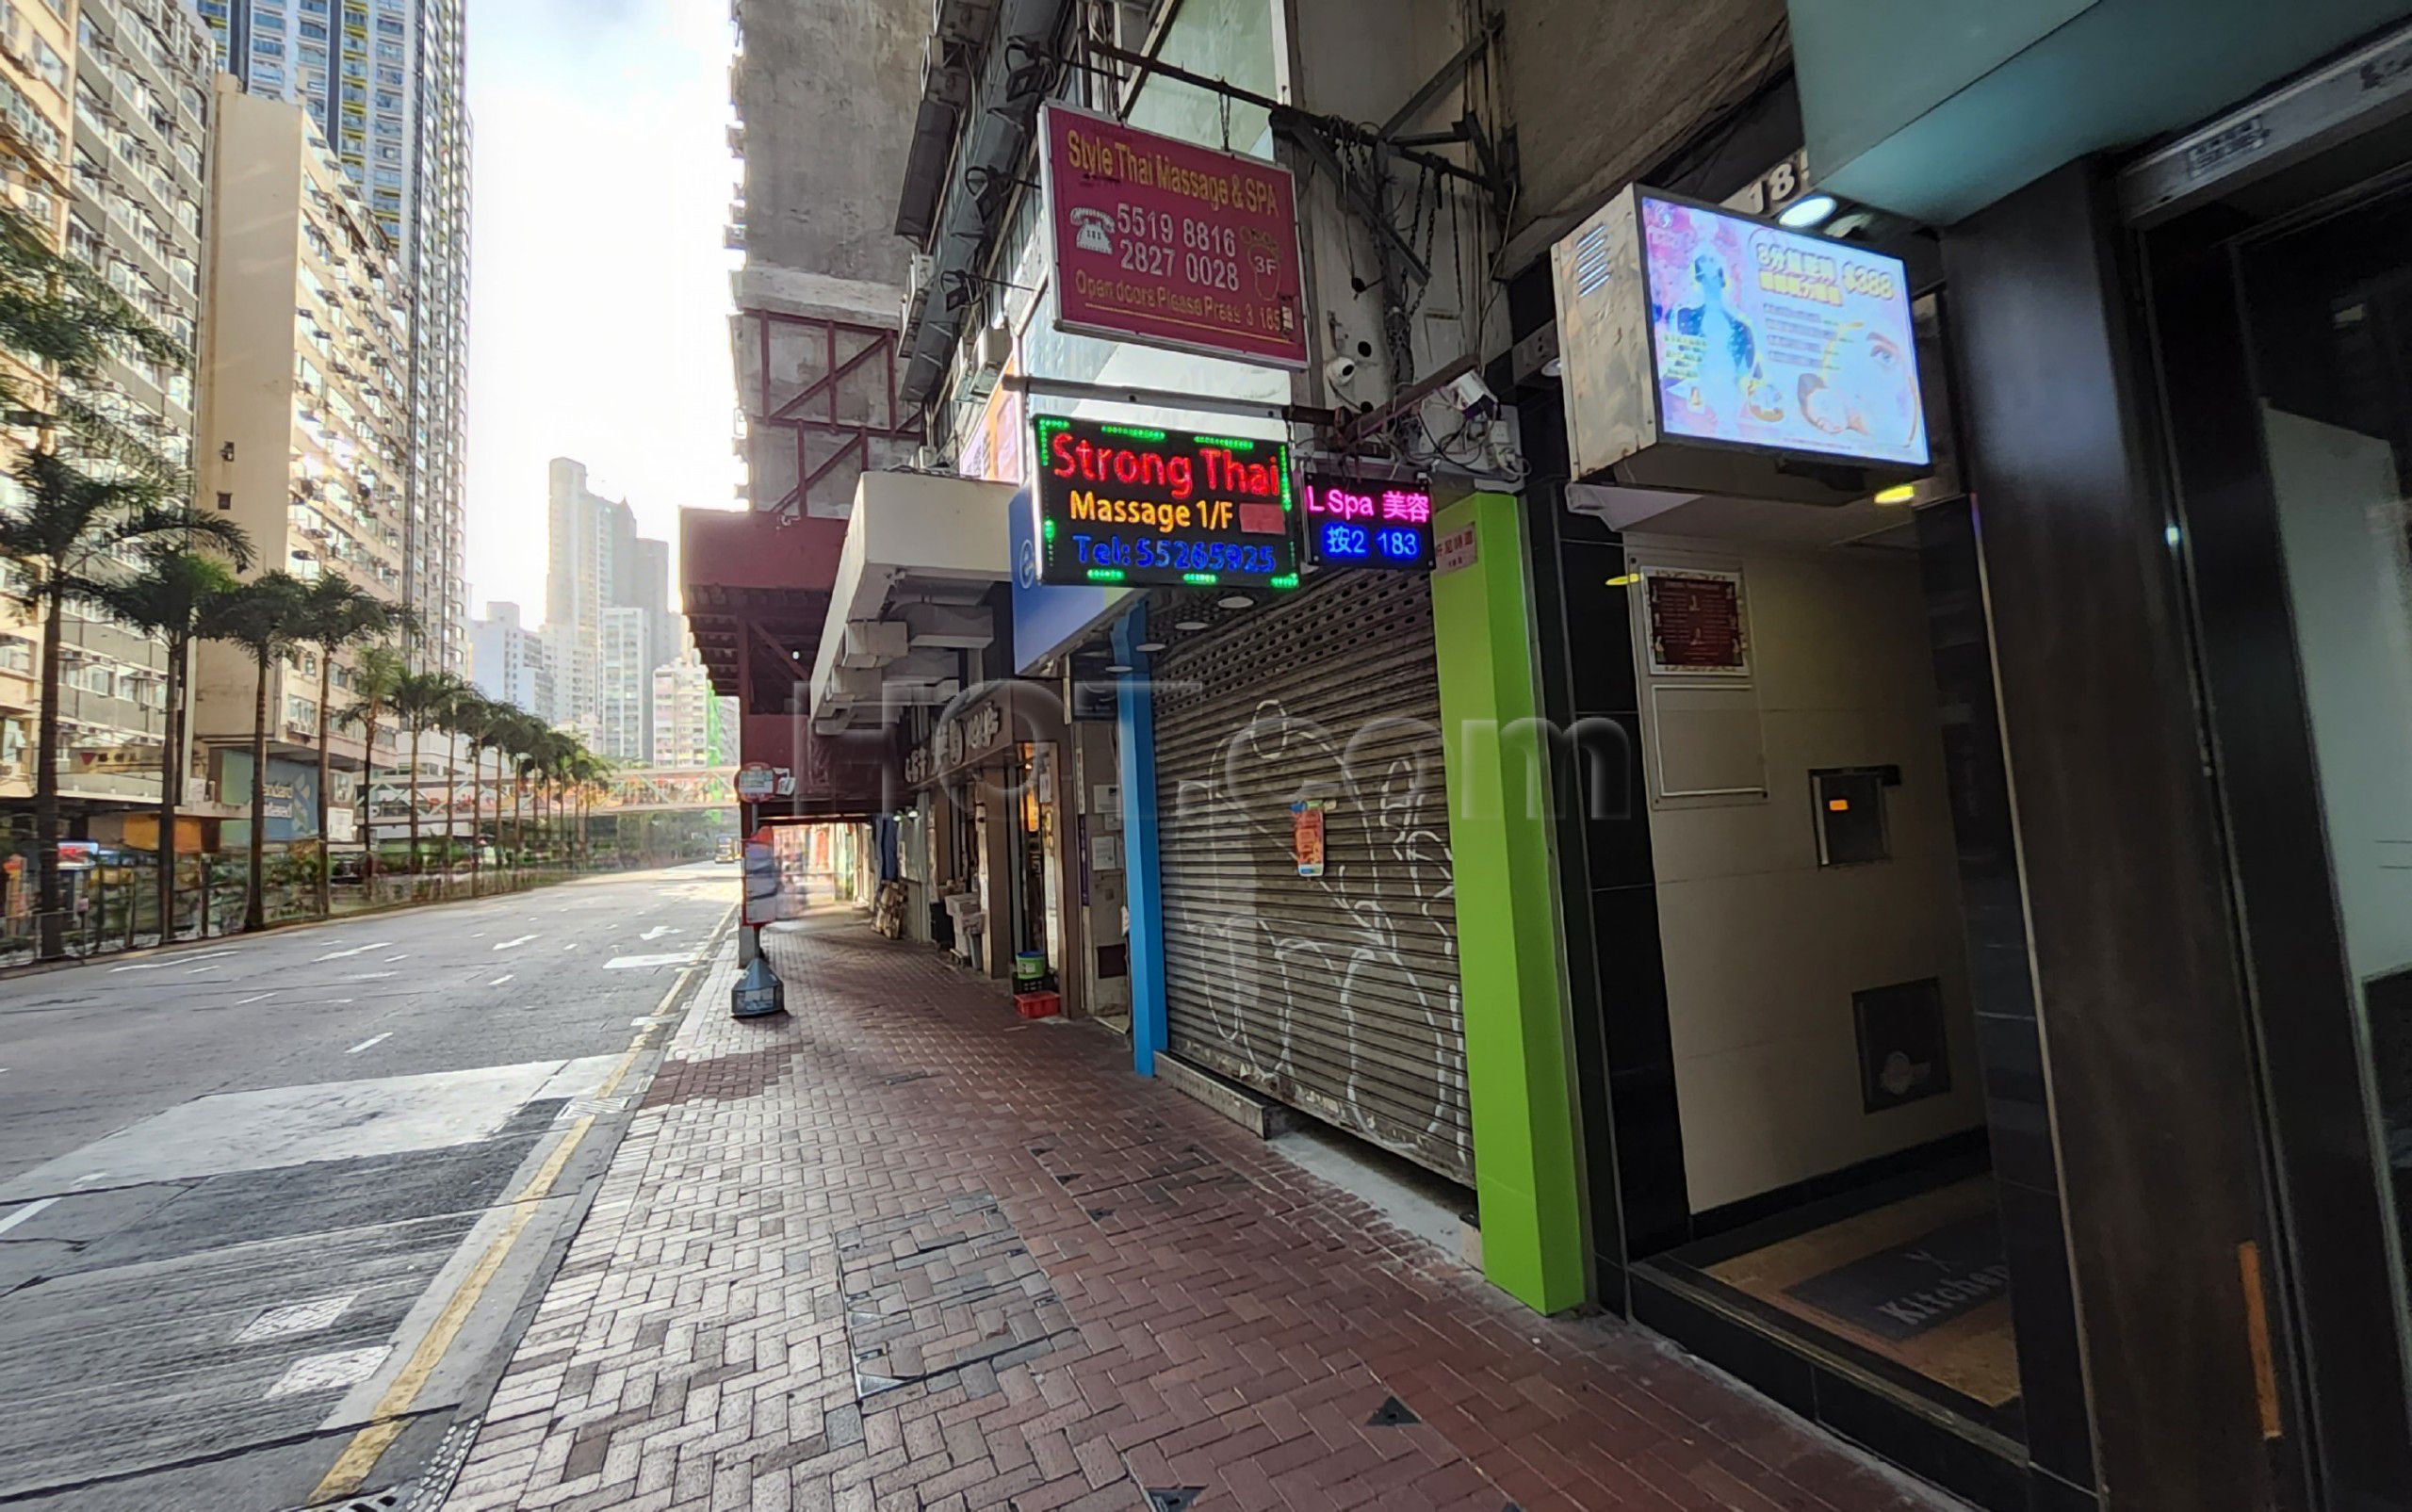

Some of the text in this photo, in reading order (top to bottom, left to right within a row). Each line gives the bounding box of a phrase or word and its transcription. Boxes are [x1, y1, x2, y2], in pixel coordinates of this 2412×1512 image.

[1067, 129, 1279, 218] Style Thai Massage & SPA
[1116, 203, 1235, 257] 5519 8816
[1120, 239, 1240, 291] 2827 0028
[1254, 255, 1277, 275] 3F
[1157, 286, 1202, 317] Please
[1204, 296, 1242, 324] Press
[1052, 432, 1193, 498] Strong
[1199, 447, 1279, 496] Thai
[1070, 489, 1233, 533] Massage 1/F
[1307, 484, 1430, 523] L Spa 美容
[1377, 531, 1417, 555] 183
